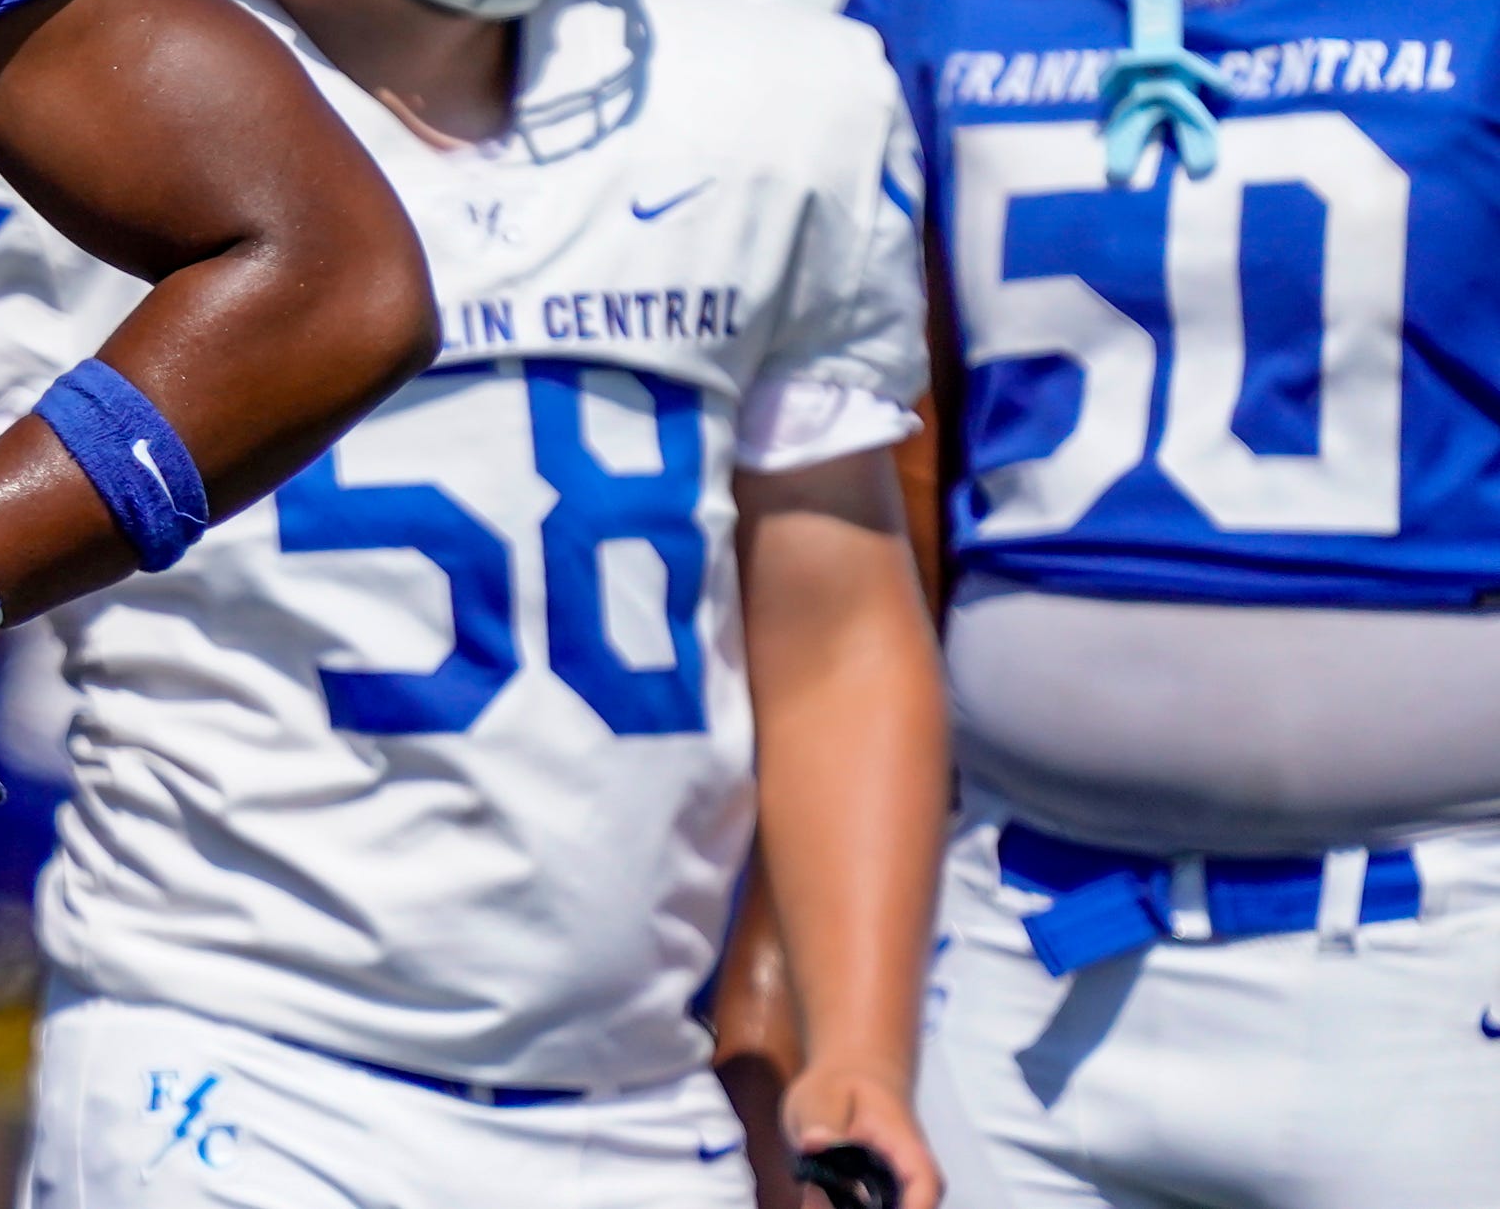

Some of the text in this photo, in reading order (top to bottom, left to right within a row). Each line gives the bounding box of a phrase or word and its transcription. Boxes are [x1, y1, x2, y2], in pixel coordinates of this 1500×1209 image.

[1217, 37, 1456, 99] CENTRAL
[543, 287, 740, 340] CENTRAL
[953, 109, 1411, 538] 50
[274, 357, 710, 738] 58
